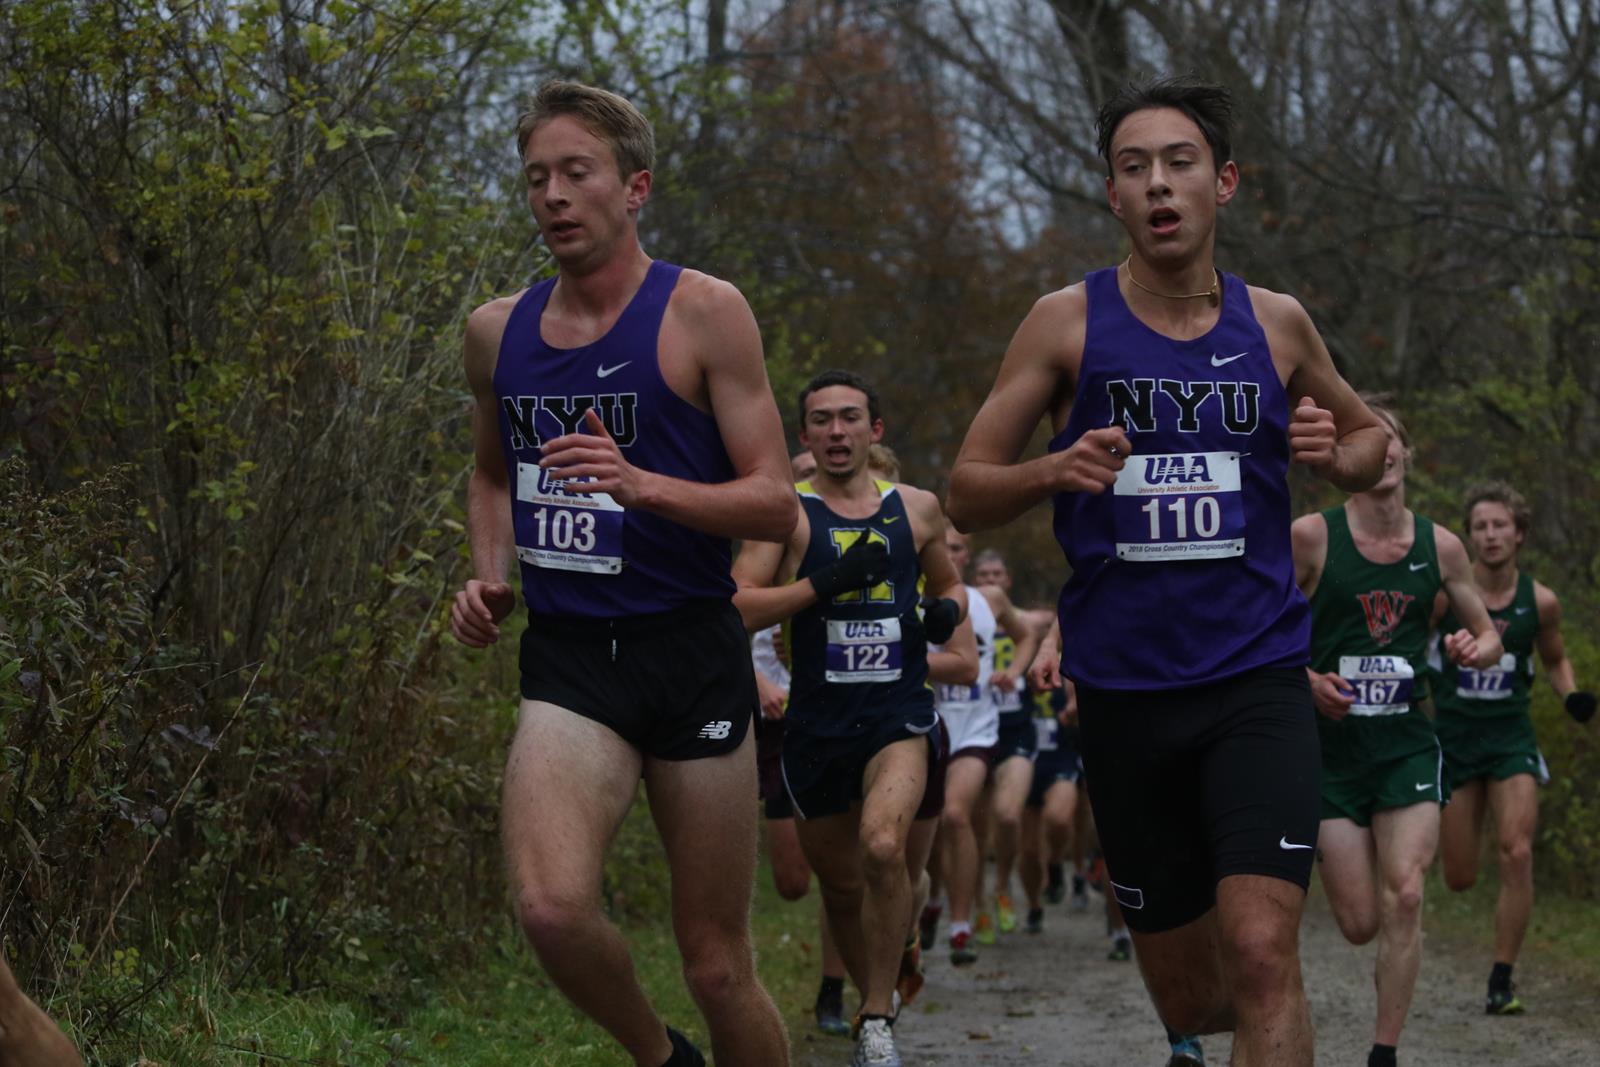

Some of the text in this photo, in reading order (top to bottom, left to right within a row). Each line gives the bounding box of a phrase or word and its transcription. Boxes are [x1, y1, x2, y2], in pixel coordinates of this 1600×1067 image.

[1107, 378, 1260, 435] NYU
[502, 393, 638, 449] NYU
[1144, 455, 1213, 485] UAA
[533, 506, 596, 552] 103
[1141, 496, 1221, 539] 110
[1144, 545, 1161, 553] Cross
[1163, 544, 1188, 553] Country
[845, 622, 885, 638] UAA
[843, 644, 890, 671] 122
[1359, 656, 1396, 673] UAA
[1355, 680, 1401, 704] 167
[1471, 669, 1504, 690] 177
